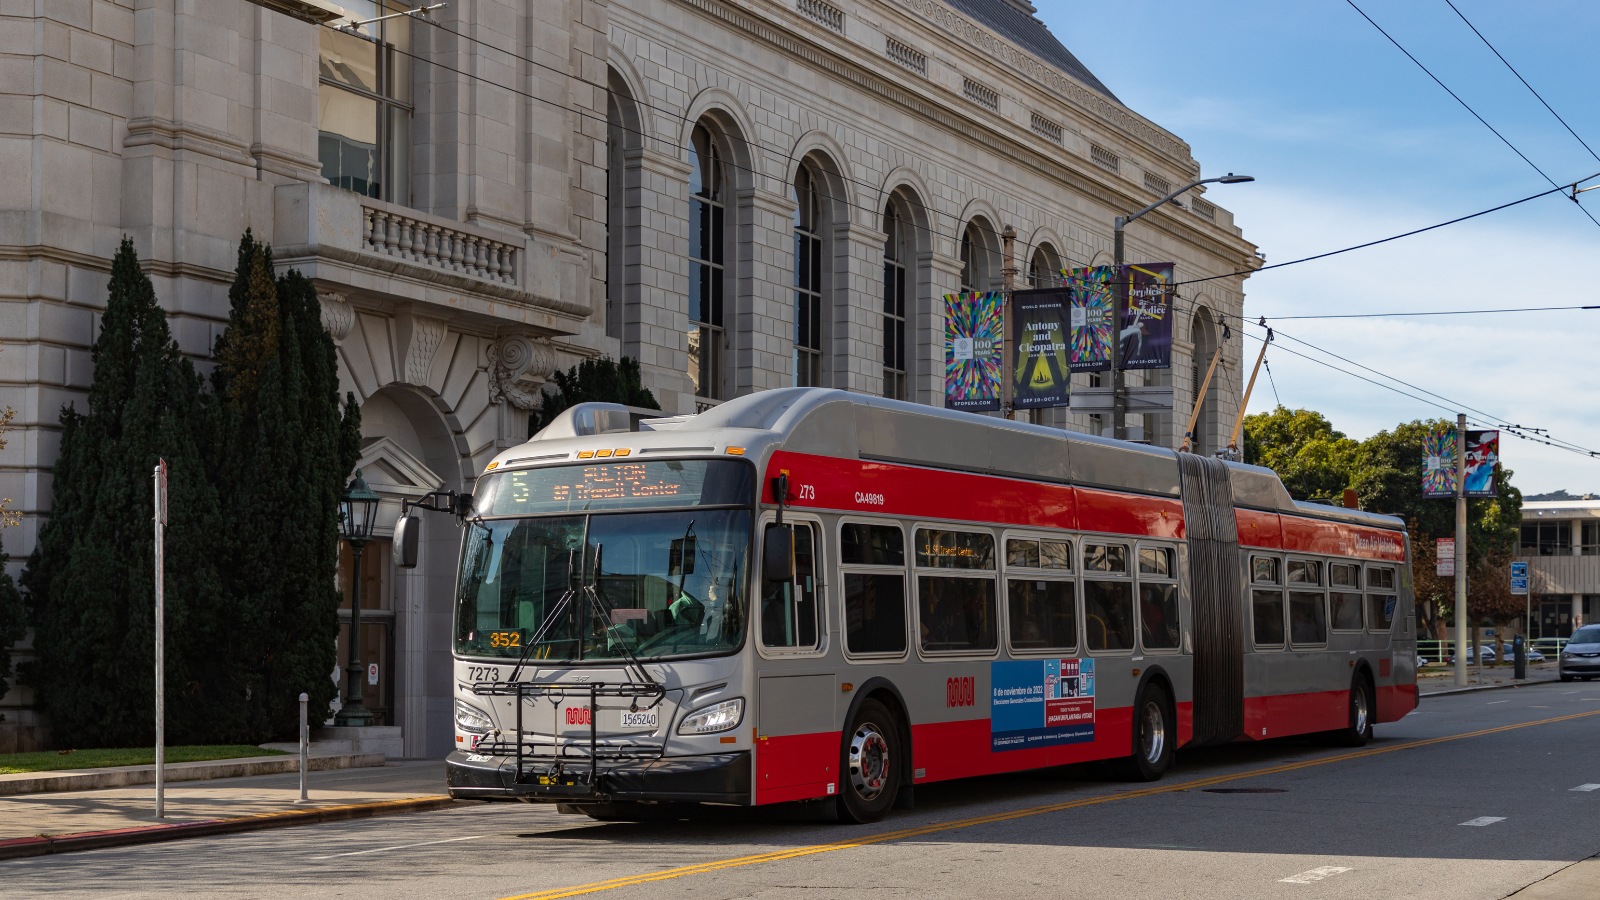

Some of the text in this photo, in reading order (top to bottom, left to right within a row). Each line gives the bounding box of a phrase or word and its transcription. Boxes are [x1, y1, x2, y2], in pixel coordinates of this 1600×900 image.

[1087, 309, 1103, 317] 100
[1128, 305, 1166, 317] Eurydice
[1024, 321, 1060, 332] Antony
[1032, 330, 1051, 341] and
[974, 340, 991, 349] 100
[1018, 342, 1066, 353] Cleopatra
[512, 471, 529, 502] 5
[575, 482, 625, 500] Transit
[632, 480, 681, 497] Center
[855, 491, 884, 506] CA49819
[1354, 533, 1396, 554] Clean Air Vehicle
[925, 544, 930, 555] 5
[940, 545, 957, 556] Transit
[490, 632, 520, 648] 352
[468, 666, 499, 682] 7273
[994, 685, 1043, 697] 8 de noviembre de 2022
[623, 713, 656, 725] 1565240
